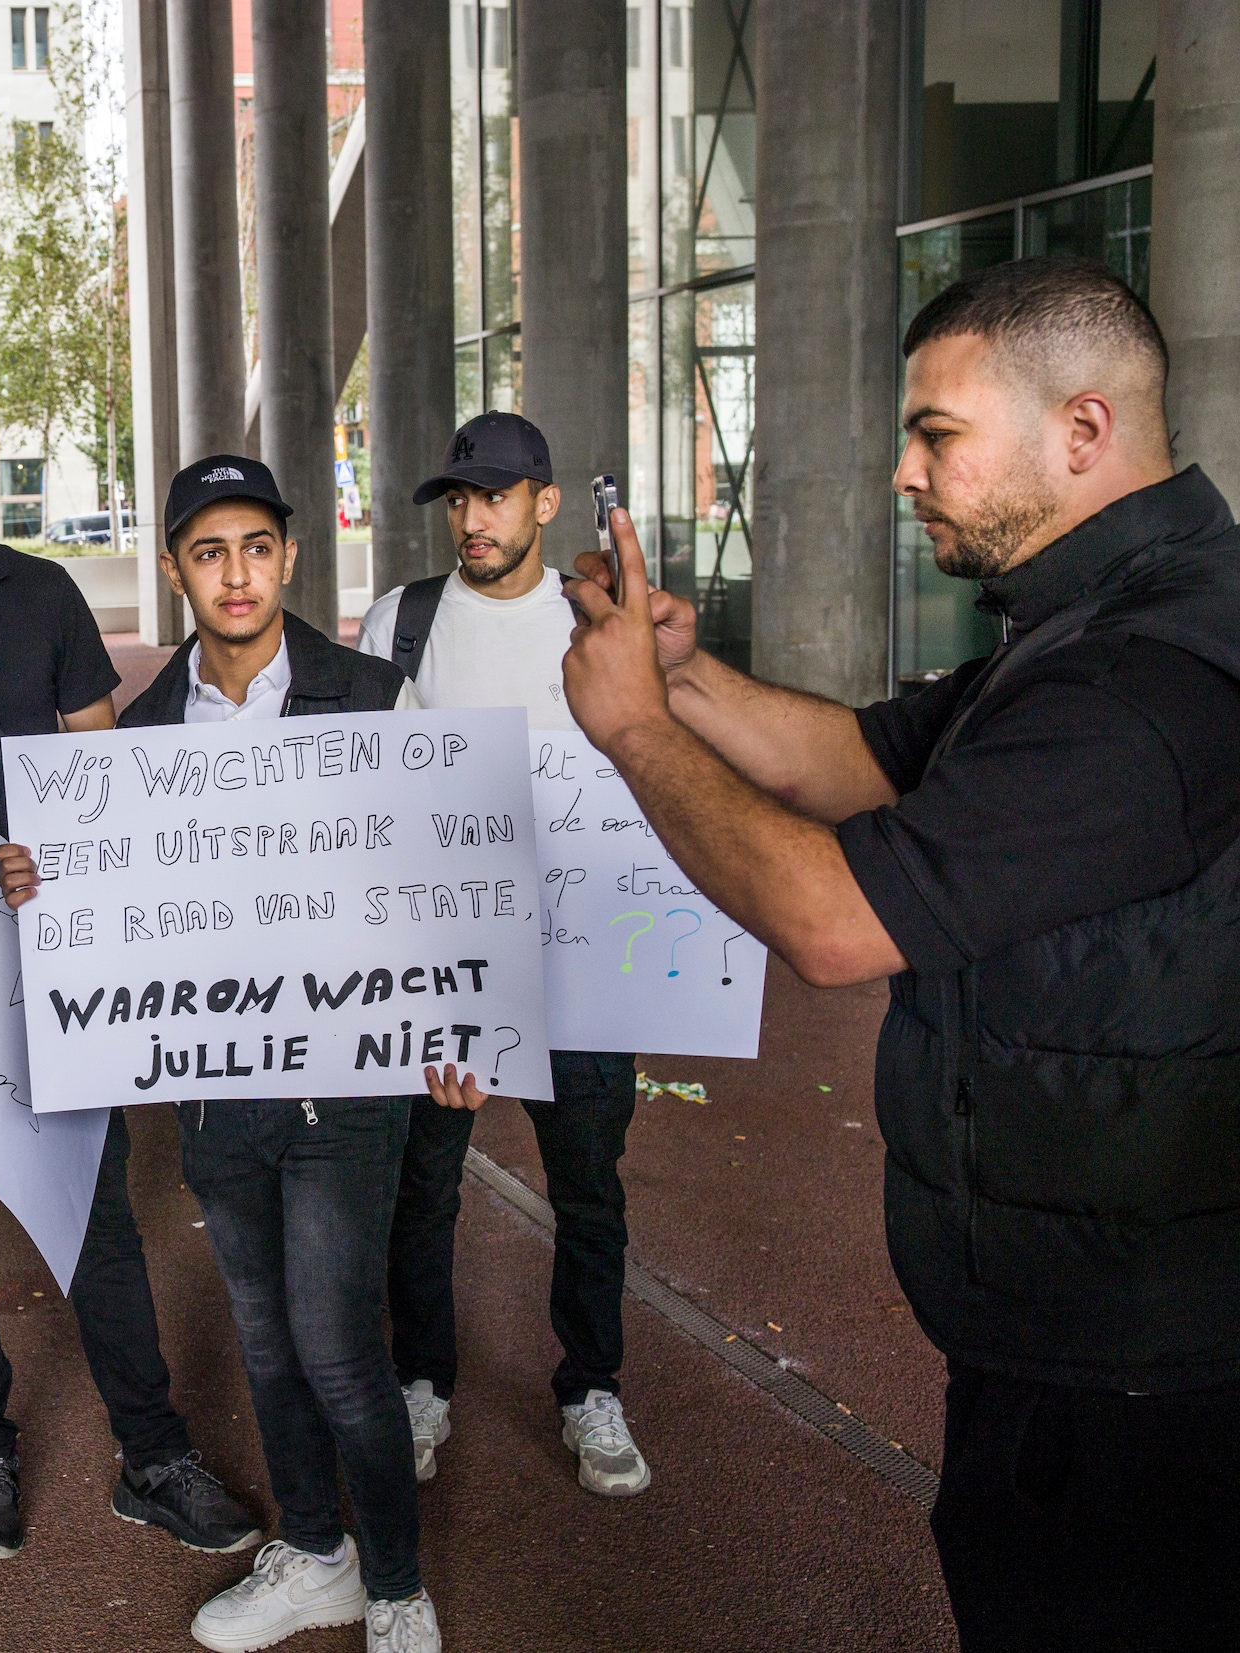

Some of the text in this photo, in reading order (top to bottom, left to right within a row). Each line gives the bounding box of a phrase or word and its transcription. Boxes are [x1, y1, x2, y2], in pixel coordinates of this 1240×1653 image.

[201, 469, 230, 483] NORTH
[131, 730, 381, 798] WACHTEN
[402, 732, 468, 770] OP
[36, 837, 131, 881] EEN
[431, 813, 515, 848] VAN
[37, 879, 532, 951] DE RAAD VAN STATE,
[545, 868, 587, 908] op
[49, 974, 285, 1035] WAAROM
[302, 959, 489, 1011] WACHT
